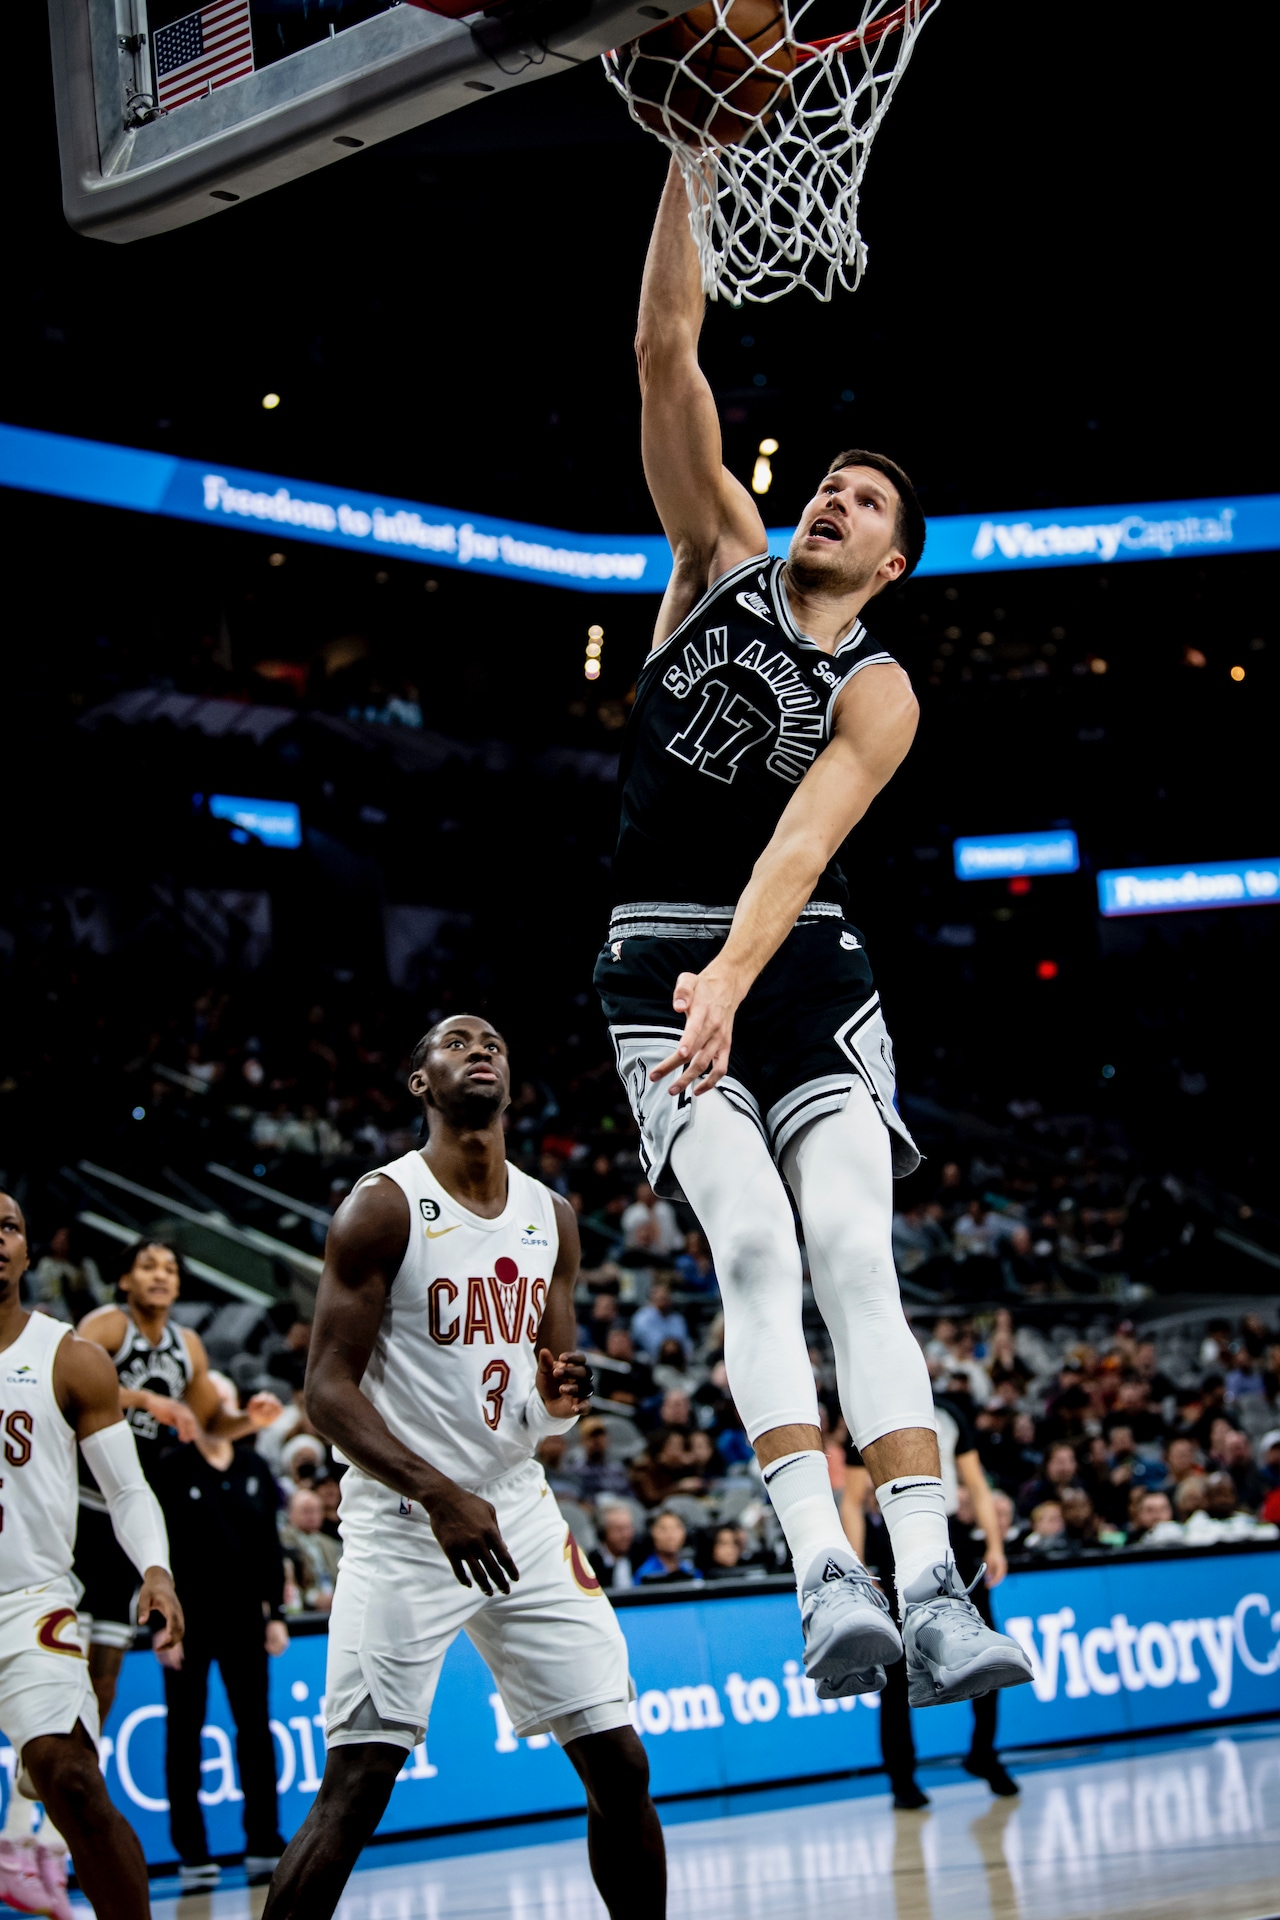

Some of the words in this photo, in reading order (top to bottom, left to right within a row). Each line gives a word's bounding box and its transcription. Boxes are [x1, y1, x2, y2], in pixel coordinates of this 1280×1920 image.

[203, 474, 337, 533] Freedom
[337, 504, 372, 538] to
[745, 592, 771, 614] NIKE
[812, 661, 842, 689] Sel
[662, 625, 729, 699] SAN
[733, 639, 825, 785] ANTONIO
[665, 679, 776, 785] 17
[421, 1202, 435, 1219] 6
[521, 1237, 548, 1246] CLIFFS
[427, 1277, 547, 1346] CAVS
[6, 1376, 38, 1385] CLIFFS
[482, 1359, 510, 1431] 3
[0, 1409, 34, 1468] S
[1004, 1592, 1280, 1709] VictoryC
[726, 1672, 780, 1724] to
